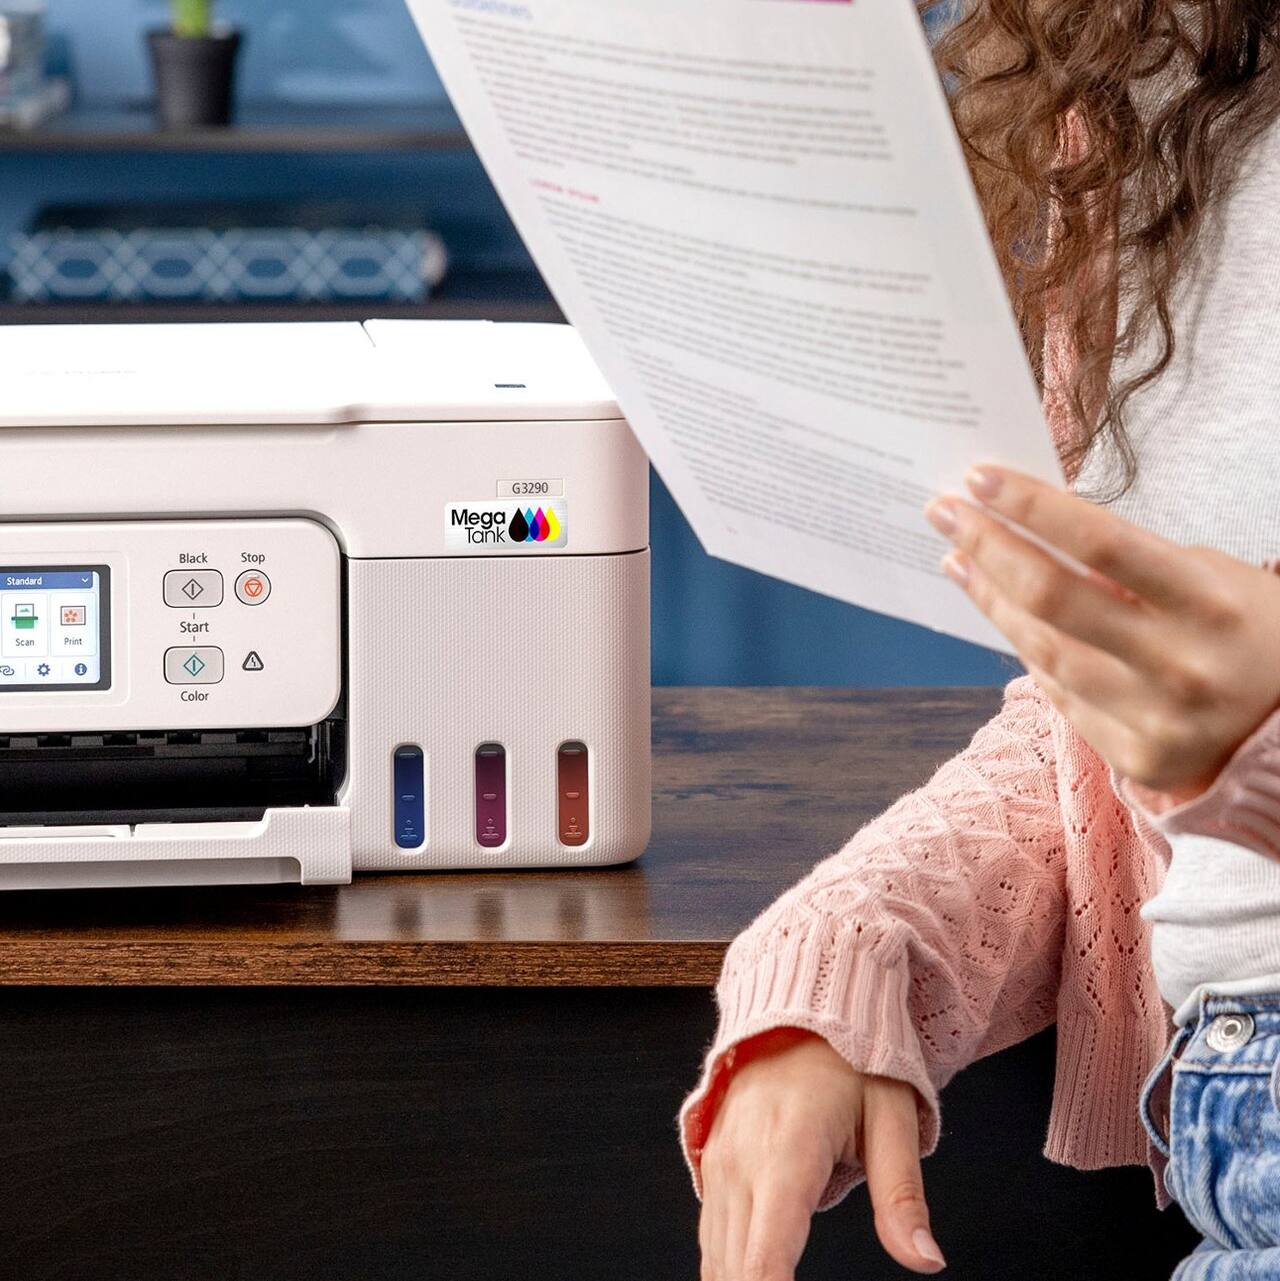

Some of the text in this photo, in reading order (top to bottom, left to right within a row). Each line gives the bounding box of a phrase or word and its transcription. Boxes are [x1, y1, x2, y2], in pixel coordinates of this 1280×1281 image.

[512, 482, 549, 494] G3290
[451, 509, 506, 529] Mega
[464, 526, 506, 544] Tank
[179, 553, 208, 564] Black
[241, 552, 266, 565] Stop
[6, 576, 43, 586] Standard
[180, 621, 210, 633] Start
[15, 637, 35, 647] Scan
[64, 636, 83, 646] Print
[180, 690, 209, 702] Color
